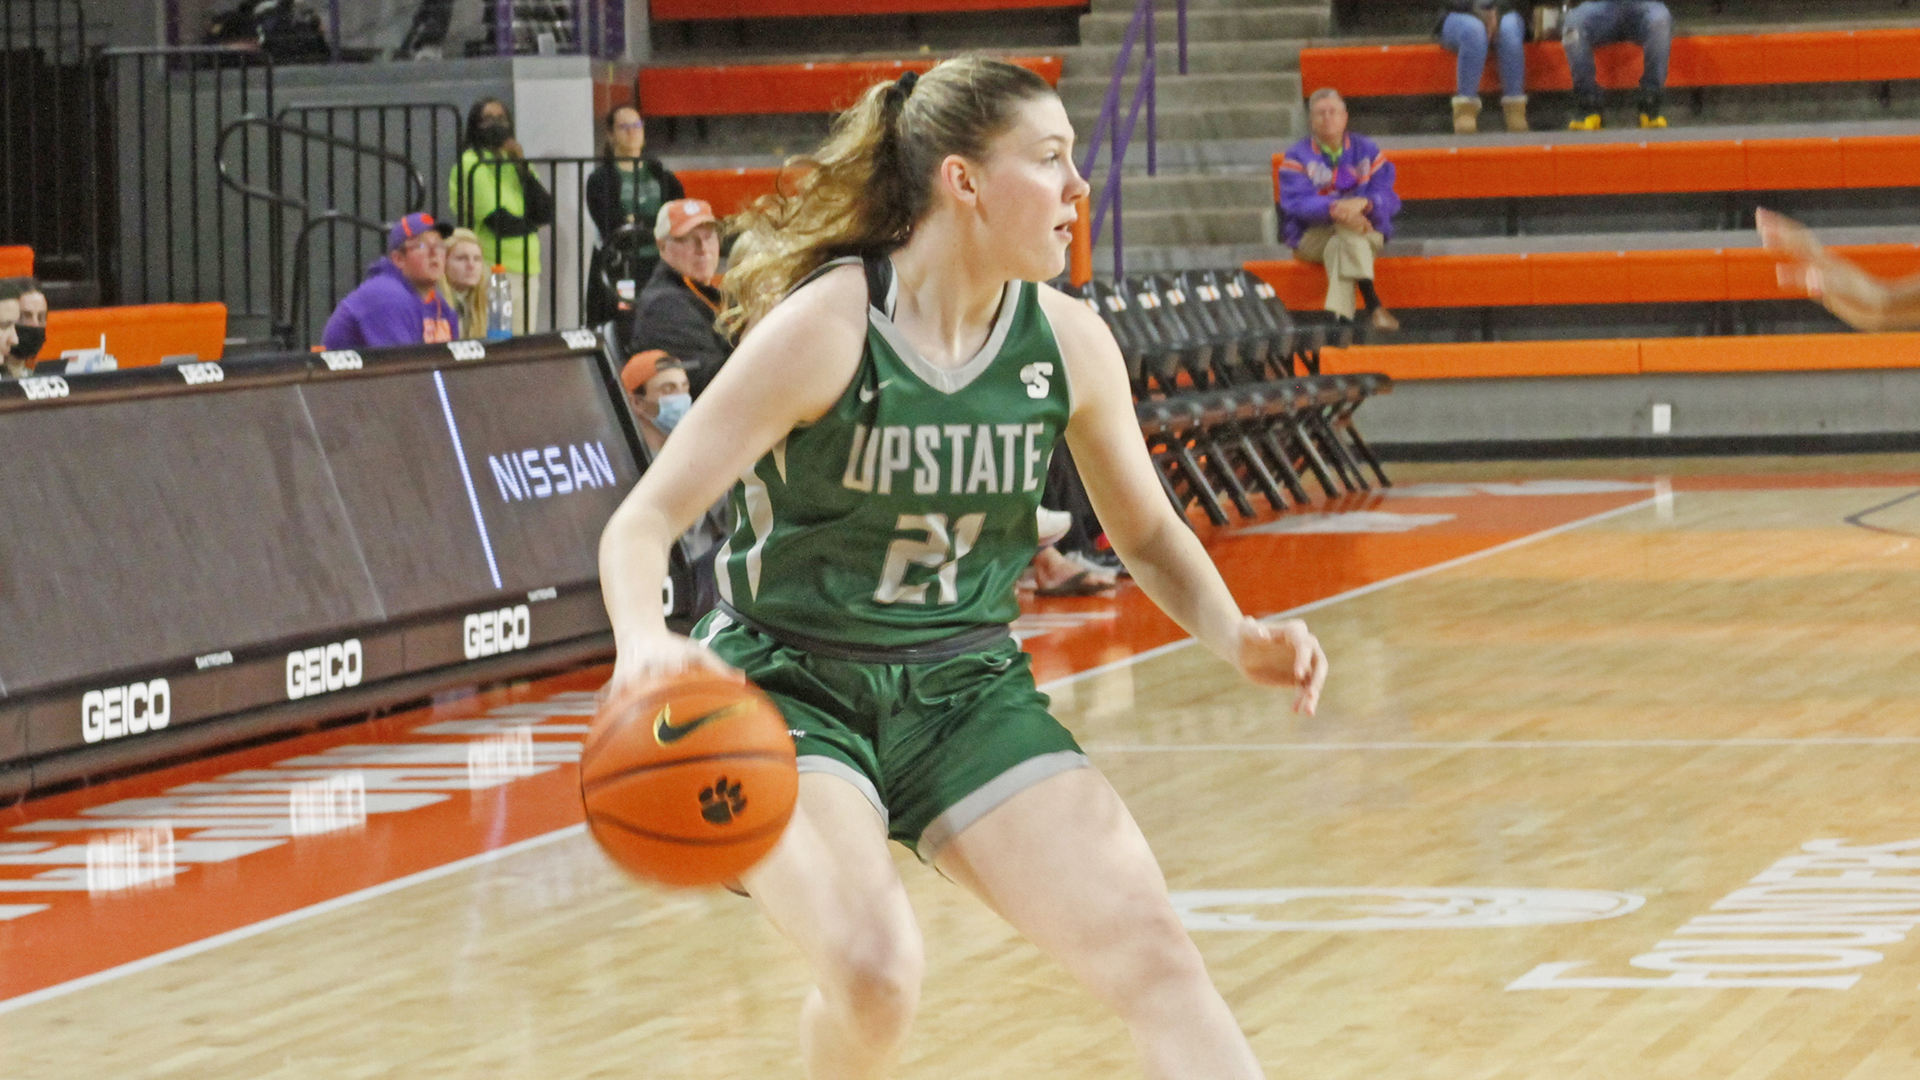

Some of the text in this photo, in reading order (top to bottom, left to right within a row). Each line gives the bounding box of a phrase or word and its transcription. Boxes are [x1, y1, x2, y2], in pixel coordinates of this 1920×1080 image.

[488, 440, 616, 503] NISSAN
[842, 422, 1044, 495] UPSTATE
[873, 512, 987, 605] 21
[464, 604, 530, 660] GEICO
[286, 639, 363, 700] GEICO
[82, 678, 171, 743] GEICO
